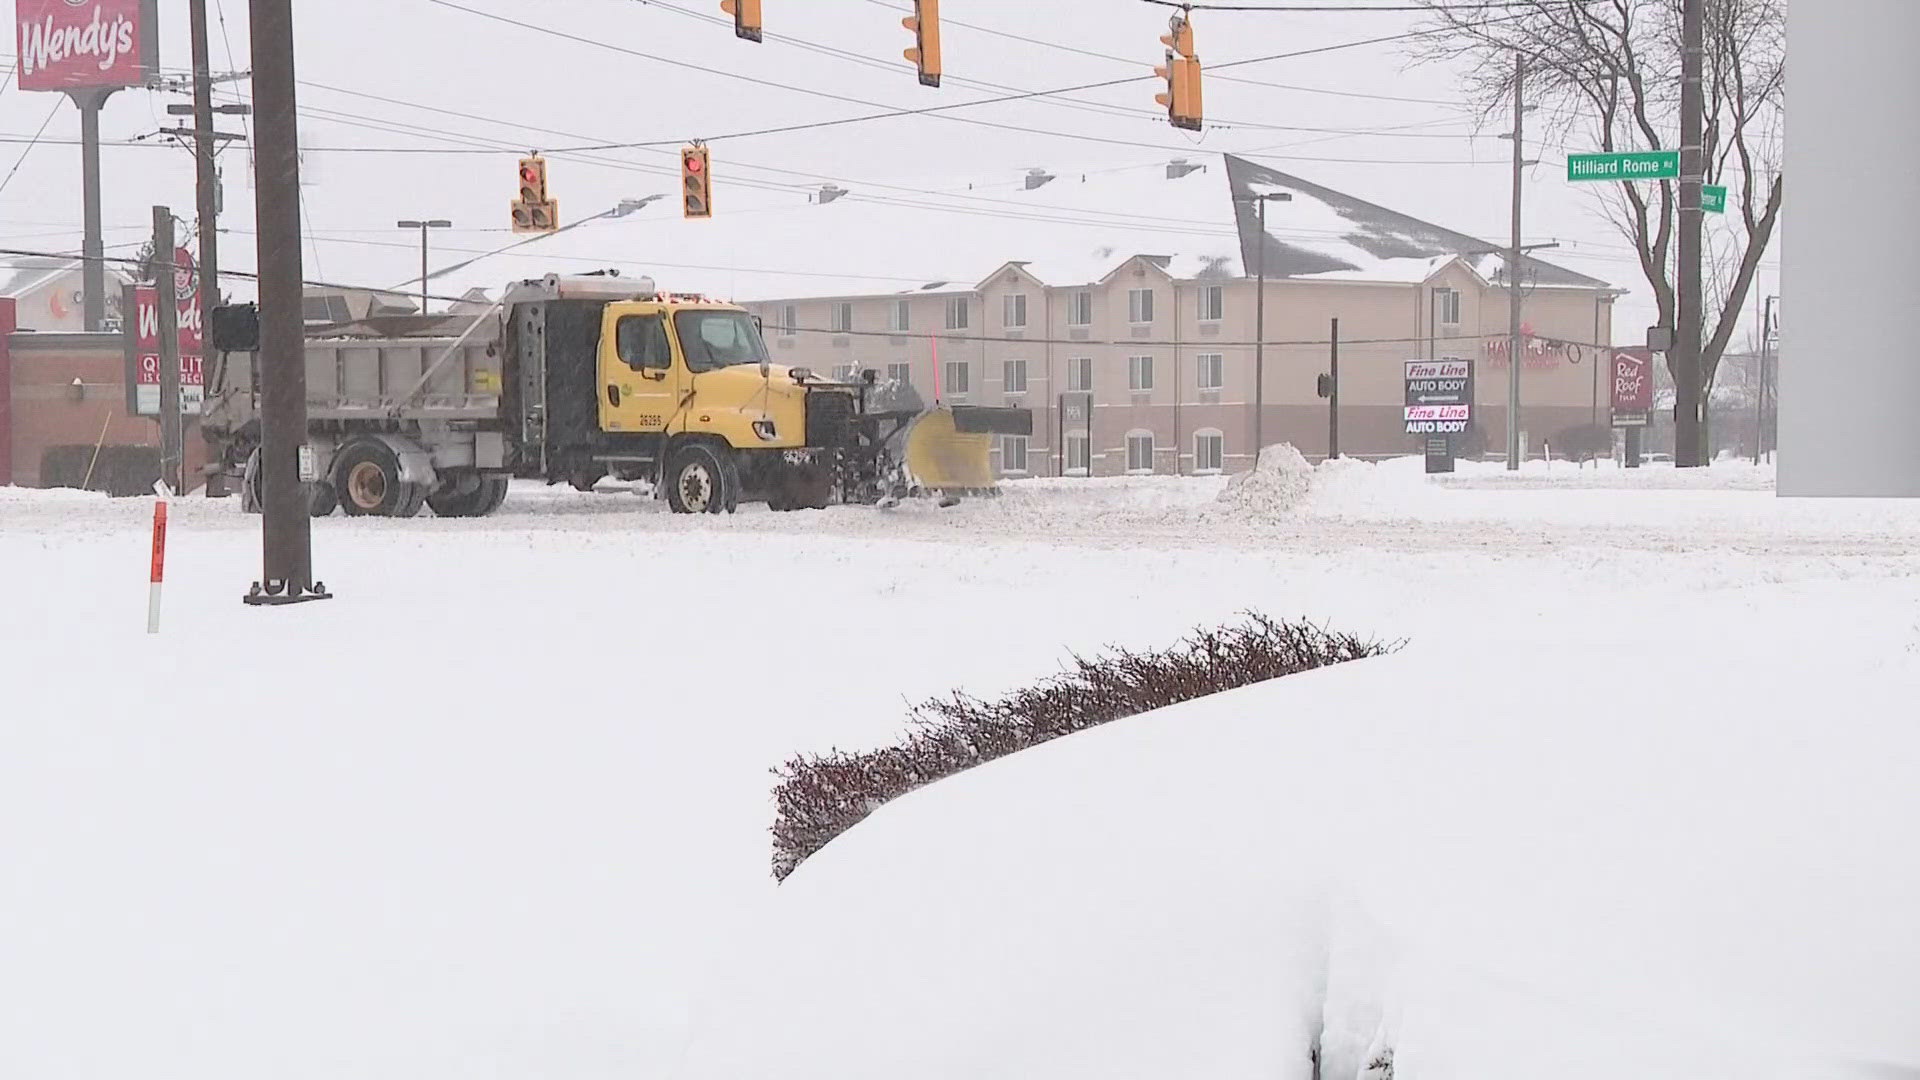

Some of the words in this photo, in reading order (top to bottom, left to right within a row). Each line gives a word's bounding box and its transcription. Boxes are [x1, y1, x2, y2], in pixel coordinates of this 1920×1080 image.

[21, 4, 134, 75] Wendy's
[1572, 159, 1618, 175] Hilliard
[1623, 158, 1659, 173] Rome
[1663, 160, 1673, 169] Rd
[143, 356, 203, 373] QLIT
[1409, 365, 1437, 377] Fine
[1439, 364, 1467, 376] Line
[1616, 362, 1639, 378] Red
[180, 373, 204, 384] RECI
[1409, 380, 1437, 392] AUTO
[1438, 379, 1466, 391] BODY
[1615, 375, 1644, 395] Roof
[1407, 405, 1436, 418] Fine
[1439, 405, 1467, 418] Line
[1405, 421, 1435, 433] AUTO
[1436, 420, 1467, 432] BODY
